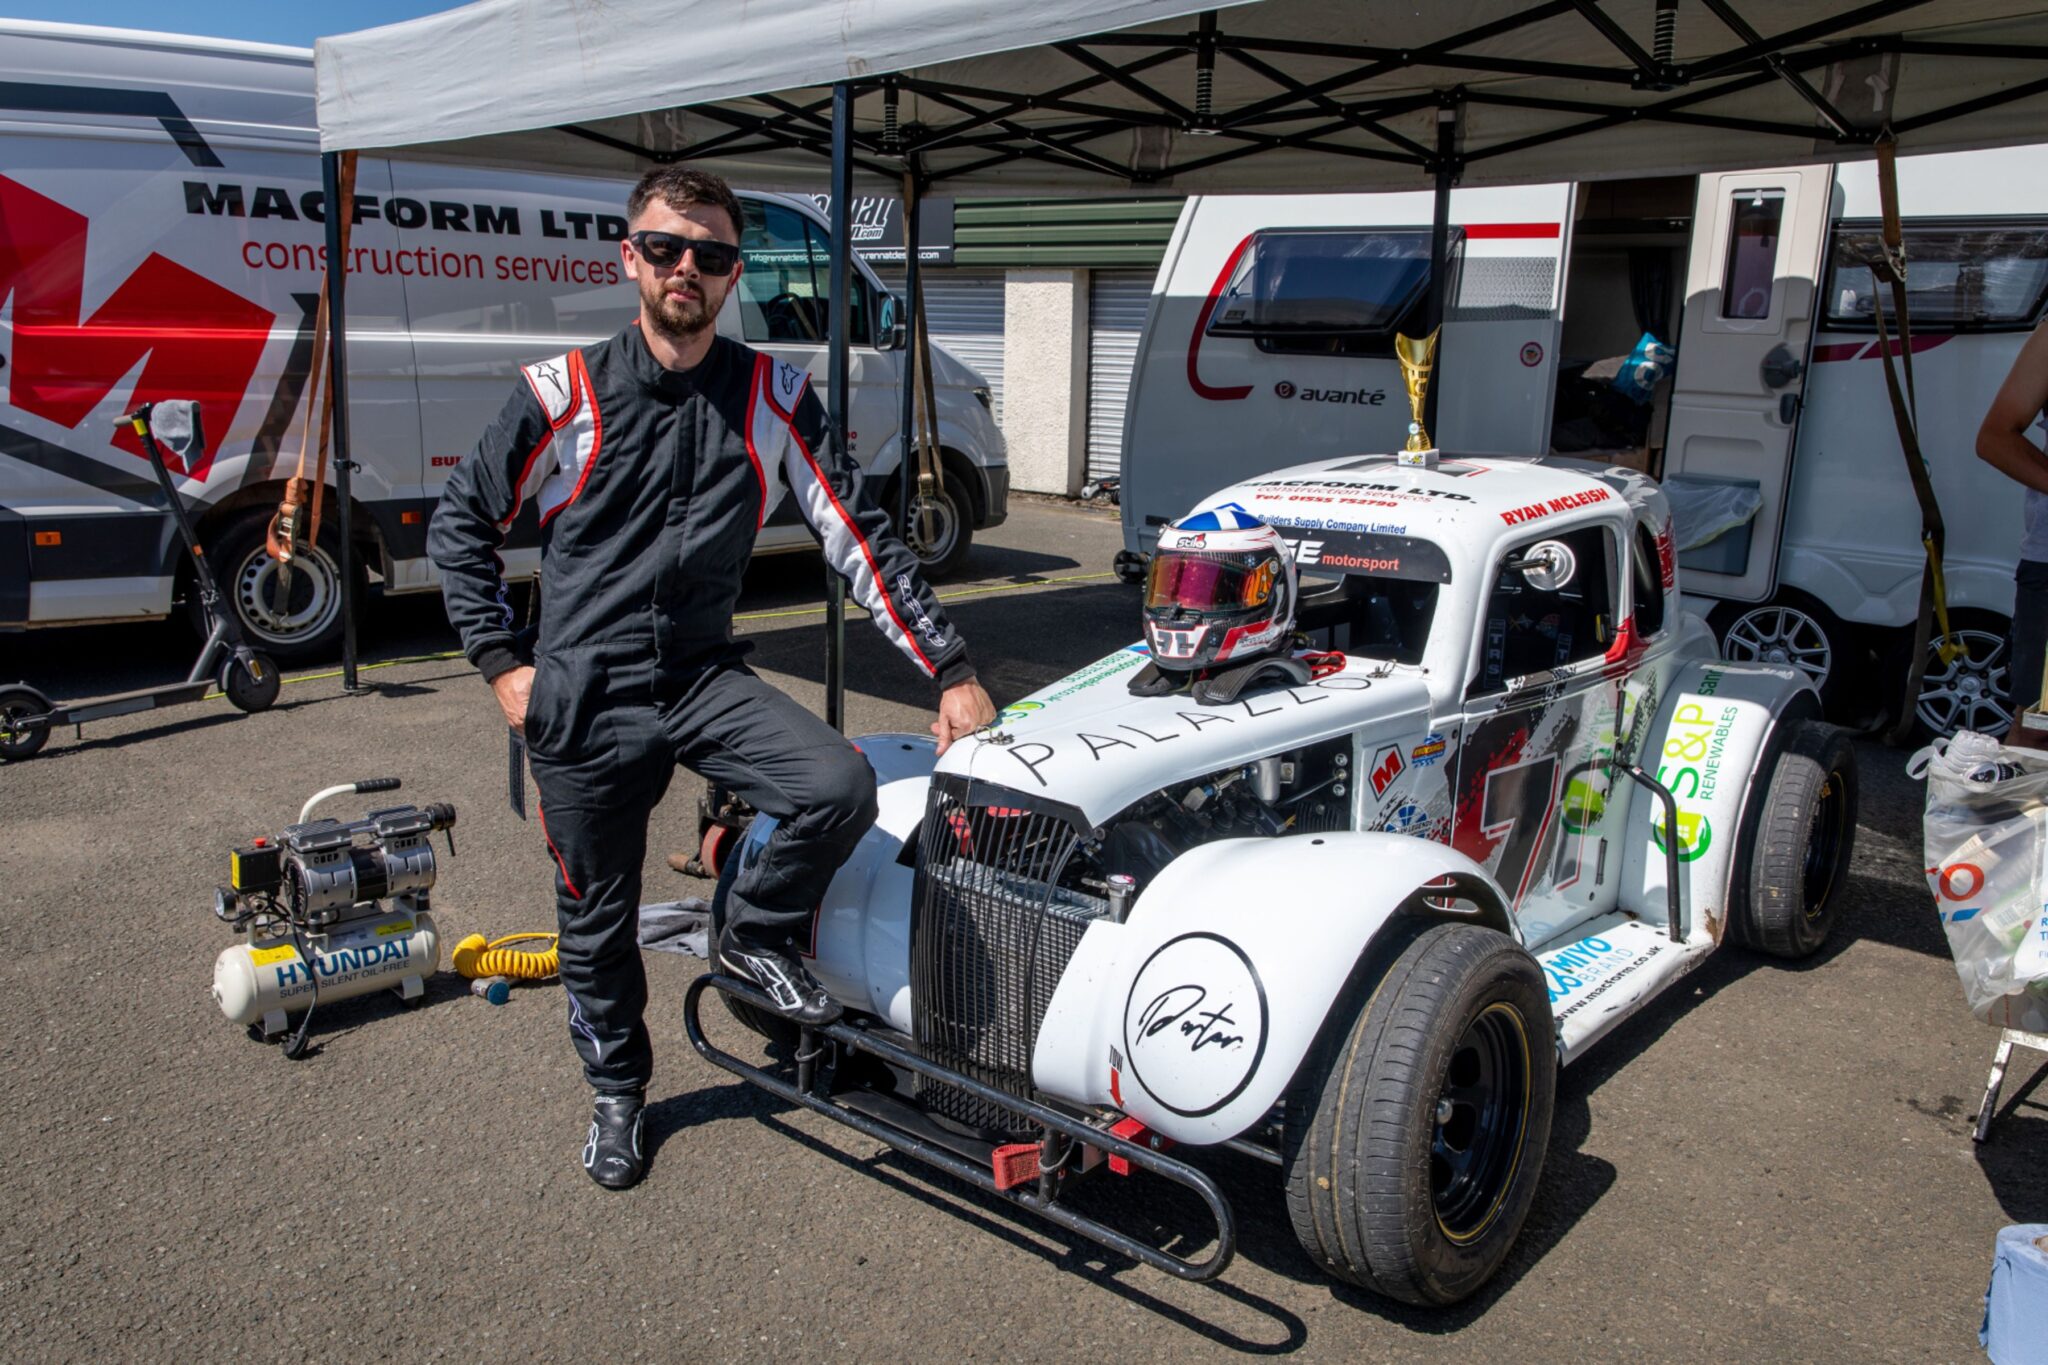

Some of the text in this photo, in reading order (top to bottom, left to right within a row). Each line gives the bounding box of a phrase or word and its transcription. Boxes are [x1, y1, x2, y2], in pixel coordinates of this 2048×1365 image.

[182, 180, 629, 242] MACFORM LTD
[495, 254, 619, 285] services
[1300, 388, 1386, 406] avanté
[1294, 516, 1324, 529] Supply
[1326, 519, 1369, 533] Company
[1371, 522, 1407, 535] Limited
[1500, 487, 1611, 527] RYAN MCLEISH
[1322, 553, 1399, 572] motorsport
[1700, 706, 1739, 800] RENEWABLES
[276, 938, 410, 988] HYUNDAI
[280, 959, 410, 999] SUPER SILENT OIL-FREE
[1578, 948, 1635, 983] BRAND
